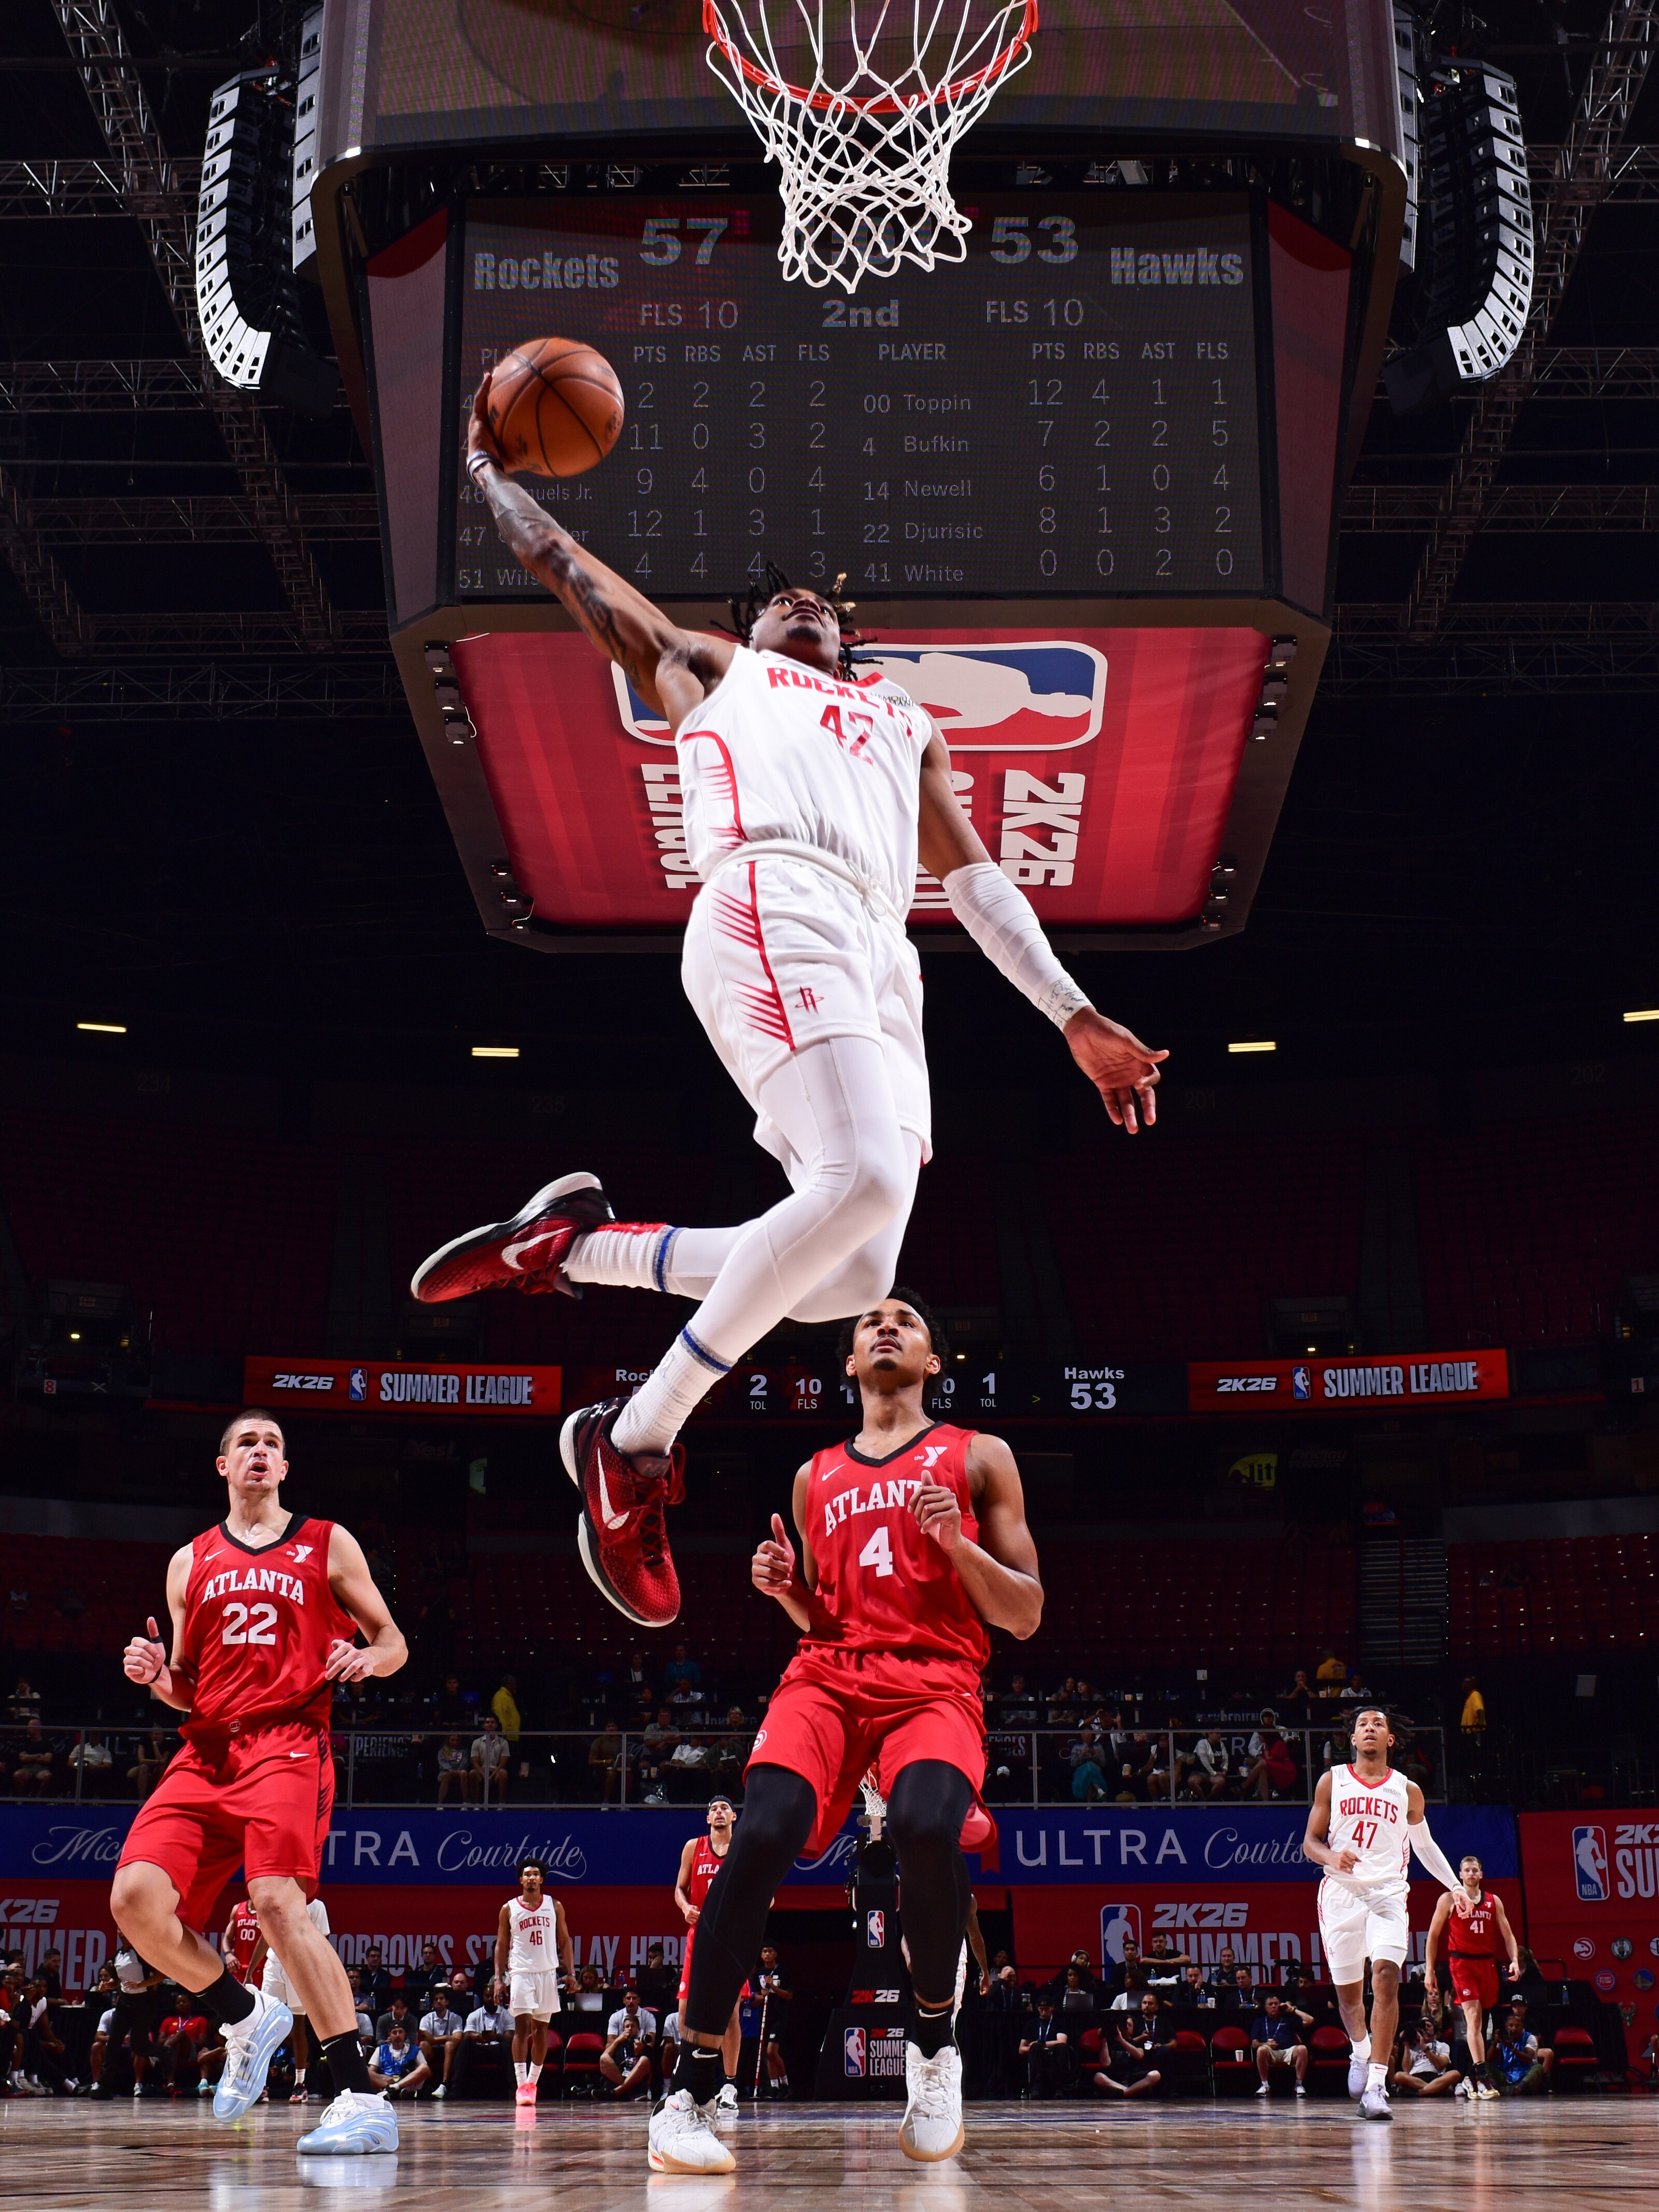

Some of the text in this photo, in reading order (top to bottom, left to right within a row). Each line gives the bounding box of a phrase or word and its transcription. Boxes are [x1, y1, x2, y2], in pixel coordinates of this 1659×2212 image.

[640, 218, 728, 265] 57
[991, 215, 1078, 264] 53
[474, 251, 620, 290] Rockets
[1110, 247, 1244, 285] Hawks
[641, 300, 738, 329] FLS 10
[822, 299, 899, 328] 2nd
[986, 299, 1084, 327] FLS 10
[634, 344, 830, 363] PTS RBS AST FLS
[878, 343, 947, 361] PLAYER
[1032, 343, 1229, 360] PTS RBS AST FLS
[639, 382, 653, 408] 2
[694, 382, 709, 407] 2
[749, 381, 765, 407] 2
[810, 381, 825, 406] 2
[864, 378, 1227, 414] 00 Toppin 12 4 1 1
[630, 422, 825, 450] 11 0 3 2
[863, 420, 1229, 456] 4 Bufkin 7 2 2 5
[460, 466, 826, 503] 46 muels Jr. 9 4 0 4
[863, 464, 1231, 501] 14 Newell 6 1 0 4
[459, 527, 486, 546] 47
[628, 510, 663, 537] 12
[693, 510, 708, 537] 1
[749, 509, 766, 536] 3
[811, 509, 825, 535] 1
[863, 506, 1232, 543] 22 Djurisic 8 1 3 2
[459, 551, 825, 588] 51 Wils 4 4 4 3
[864, 549, 1233, 582] 41 White 0 0 2 0
[819, 705, 875, 767] 42
[1000, 769, 1086, 886] 2K26
[45, 1380, 54, 1393] 8
[750, 1374, 767, 1396] 2
[795, 1378, 822, 1395] 10
[982, 1373, 995, 1394] 1
[1063, 1367, 1124, 1380] Hawks
[1217, 1377, 1277, 1392] 2K26
[1324, 1365, 1404, 1398] SUMMER
[1410, 1361, 1479, 1394] LEAGUE
[1633, 1379, 1642, 1392] 1
[272, 1374, 334, 1390] 2K26
[379, 1373, 460, 1404] SUMMER
[466, 1375, 533, 1405] LEAGUE
[980, 1398, 997, 1408] TOL
[1070, 1383, 1117, 1410] 53
[750, 1400, 766, 1411] TOL
[797, 1399, 818, 1410] FLS
[932, 1398, 952, 1409] FLS
[825, 1479, 924, 1537] ATLANT
[859, 1526, 893, 1577] 4
[201, 1568, 305, 1605] ATLANTA
[222, 1602, 278, 1645] 22
[1340, 1796, 1398, 1824] ROCKETS
[1016, 1827, 1317, 1869] ULTRA Courts
[1352, 1820, 1379, 1849] 47
[1614, 1824, 1659, 1844] 2K
[328, 1830, 420, 1866] TRA
[437, 1830, 586, 1880] Courtside
[697, 1863, 720, 1875] ATLA
[1582, 1883, 1597, 1896] NBA
[519, 1915, 550, 1932] ROCKETS
[1151, 1903, 1249, 1928] 2K26
[1470, 1920, 1484, 1934] 41
[240, 1928, 256, 1941] 00
[529, 1930, 543, 1946] 46
[3, 1928, 107, 1990] MMER
[569, 1935, 620, 1978] LAY
[851, 1989, 900, 2004] 2K26
[870, 2027, 905, 2039] 2K26
[848, 2065, 858, 2074] NBA
[869, 2058, 906, 2076] LEAGUE
